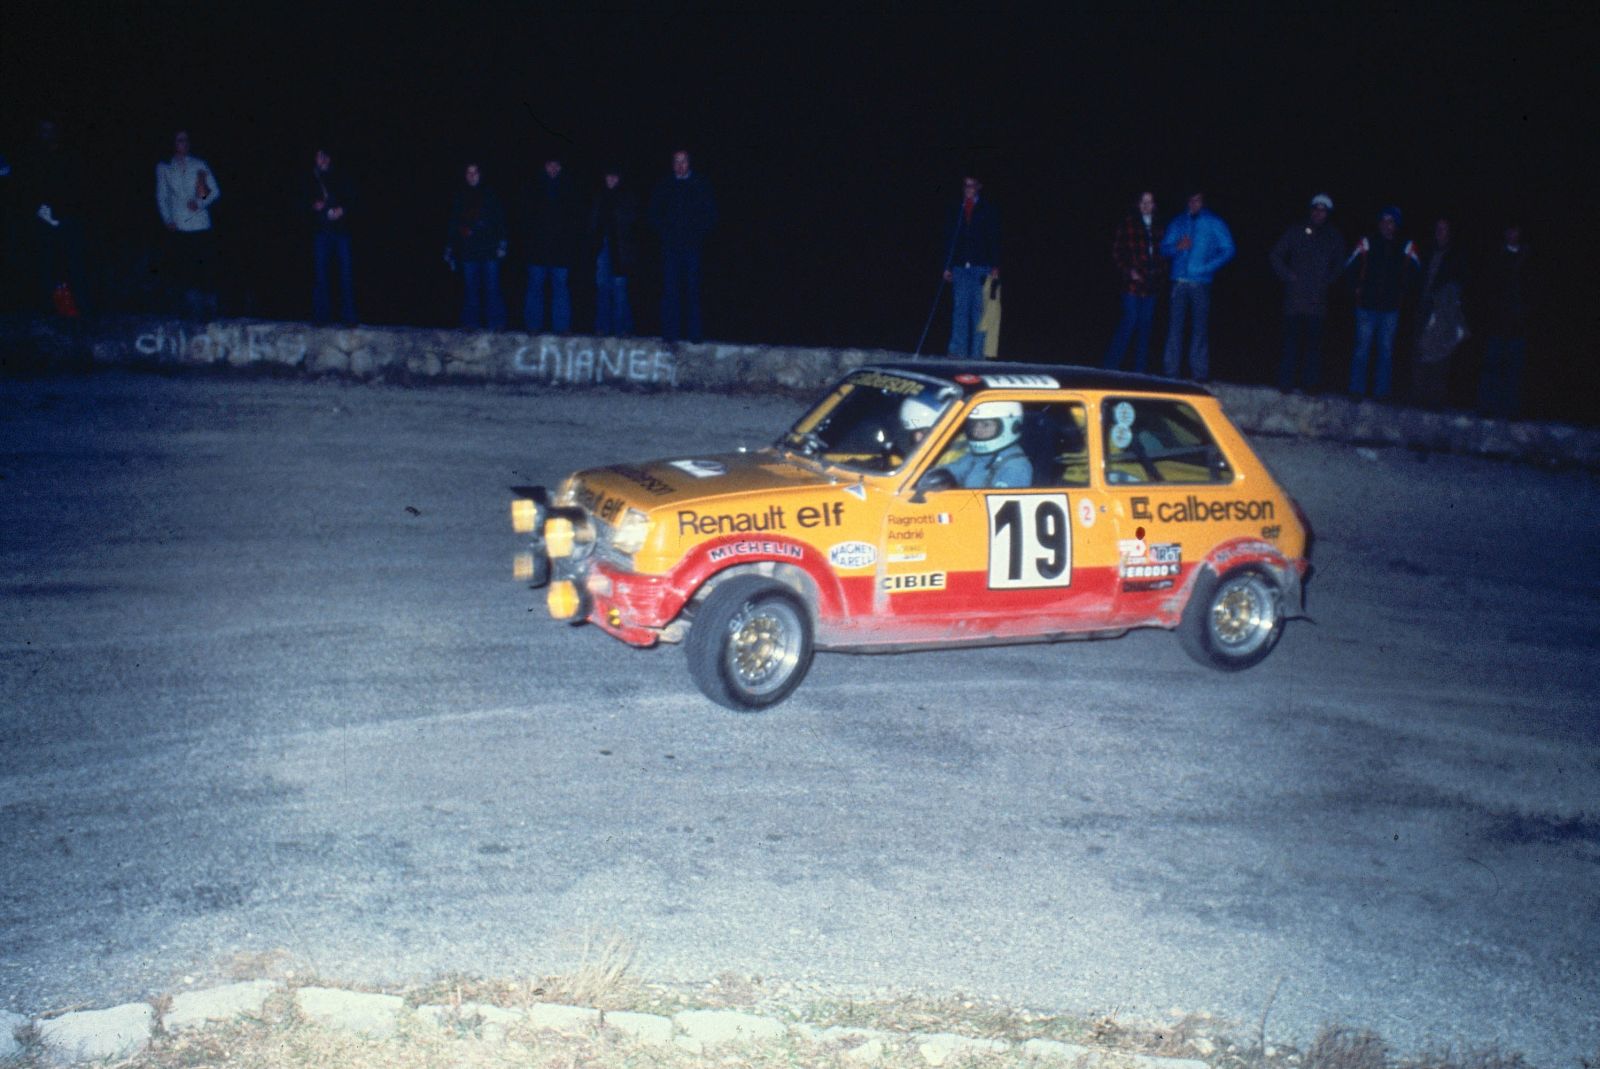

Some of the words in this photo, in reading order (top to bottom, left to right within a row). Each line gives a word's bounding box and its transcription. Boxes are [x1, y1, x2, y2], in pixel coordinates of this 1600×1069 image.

[677, 506, 787, 536] Renault
[797, 501, 845, 528] elf
[888, 514, 935, 527] Ragnotti
[1082, 505, 1092, 521] 2
[1157, 495, 1275, 522] calberson
[709, 541, 803, 562] MICHELIN
[993, 500, 1068, 581] 19
